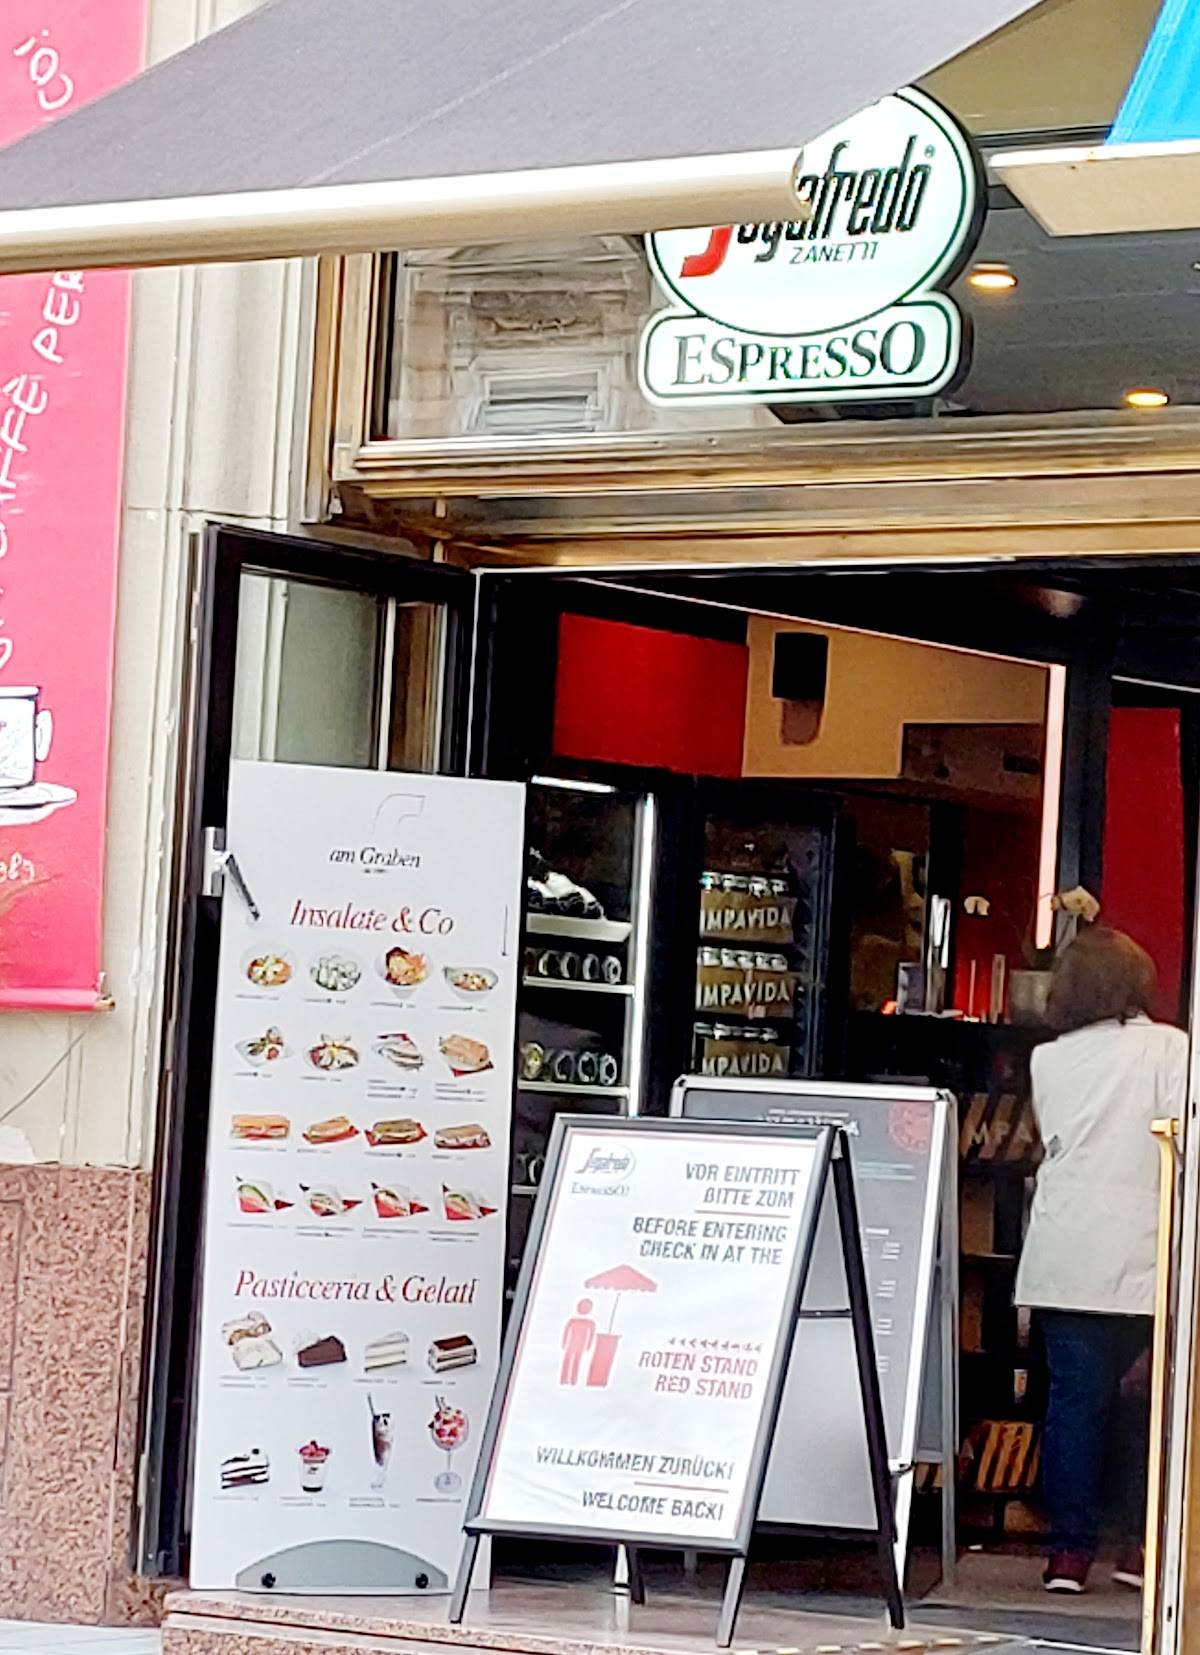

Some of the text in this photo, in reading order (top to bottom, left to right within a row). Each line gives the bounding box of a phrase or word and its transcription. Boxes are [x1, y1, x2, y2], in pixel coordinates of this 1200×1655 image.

[789, 241, 879, 265] ZANETTI
[671, 321, 926, 387] ESPRESSO
[359, 846, 420, 868] Graben
[290, 898, 454, 936] Insalate & Co
[686, 1162, 801, 1186] VOR EINTRITT
[703, 1188, 794, 1209] BITTE ZUM
[633, 1216, 787, 1243] BEFORE ENTERING
[640, 1239, 783, 1266] CHECK IN AT THE
[234, 1269, 371, 1301] Pasticceria
[375, 1274, 397, 1304] &
[638, 1350, 758, 1378] ROTEN STAND
[654, 1373, 753, 1400] RED STAND
[536, 1446, 734, 1480] WILLKOMMEN ZURÜCK!
[582, 1490, 723, 1521] WELCOME BACK!
